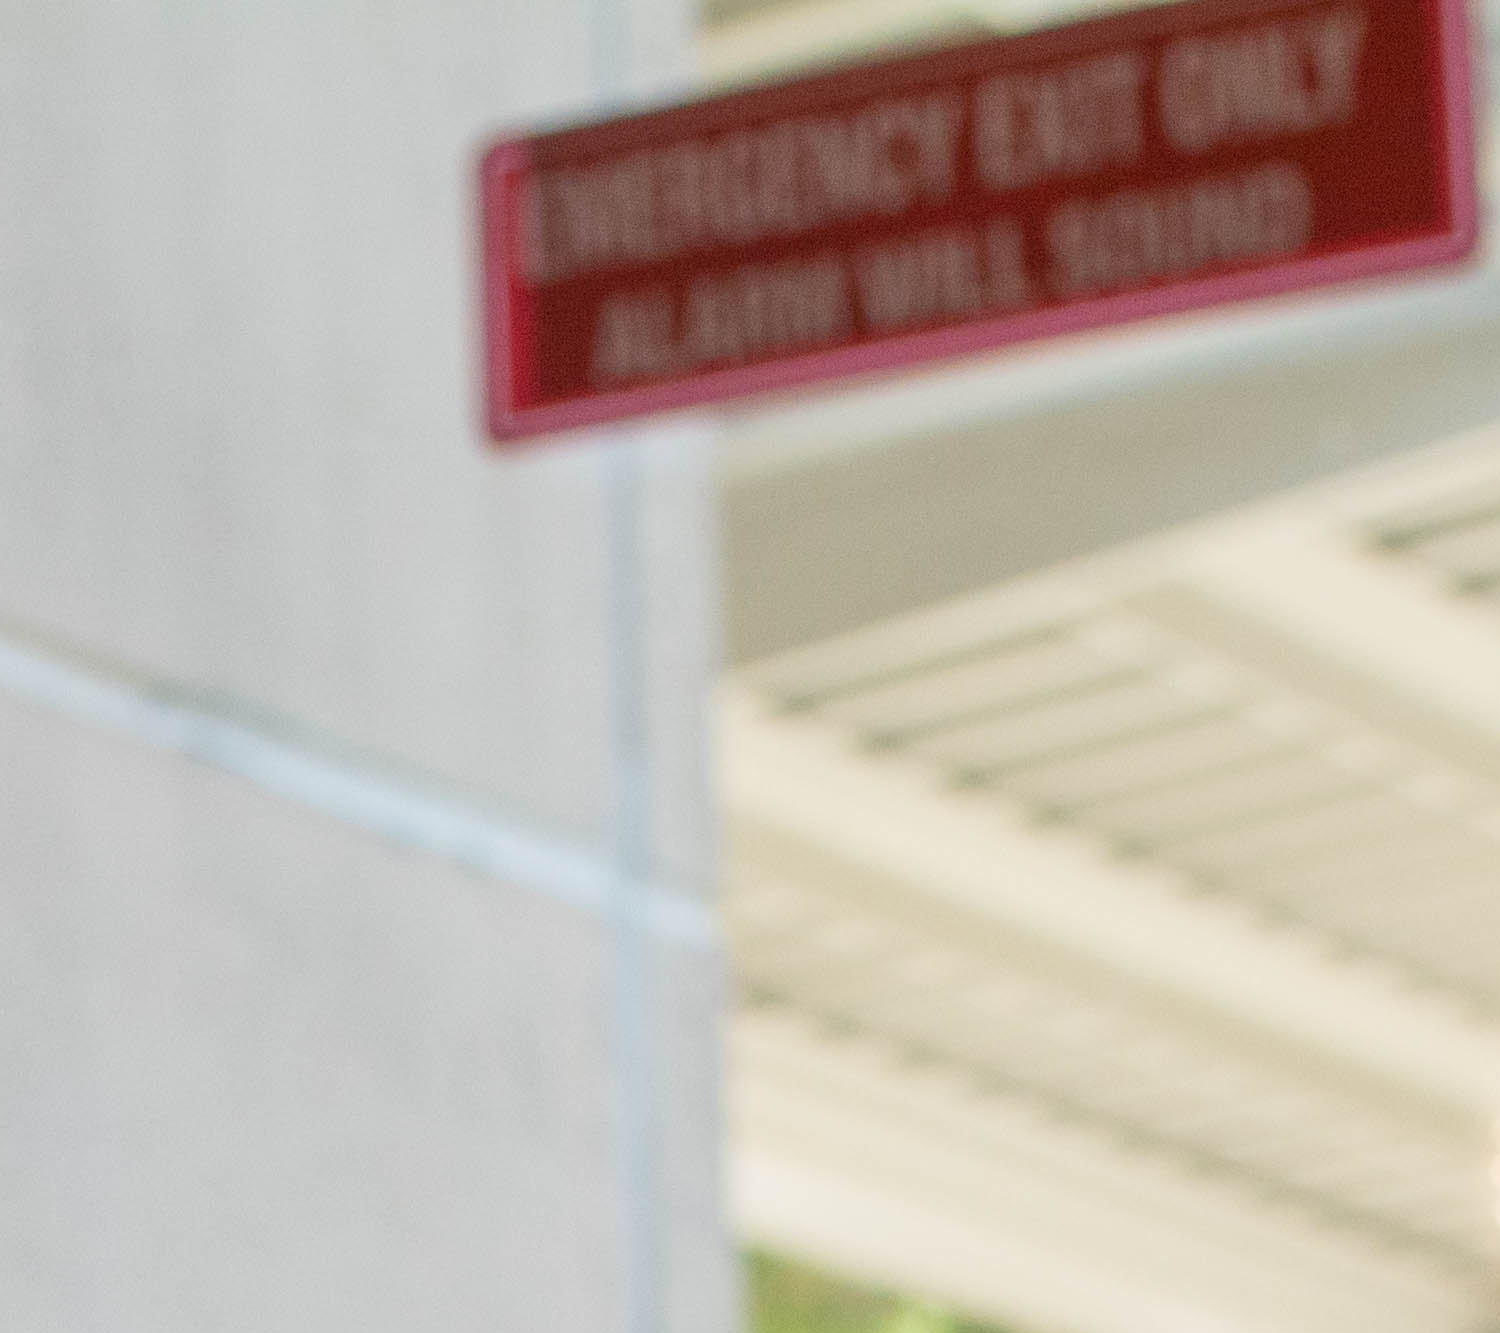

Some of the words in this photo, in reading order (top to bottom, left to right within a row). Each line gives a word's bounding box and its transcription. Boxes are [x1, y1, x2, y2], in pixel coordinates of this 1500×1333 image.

[975, 51, 1146, 190] EXIT
[1160, 7, 1367, 155] ONLY
[591, 256, 846, 381] ALARM
[858, 217, 1031, 331] WILL
[1047, 162, 1314, 294] SOUND
